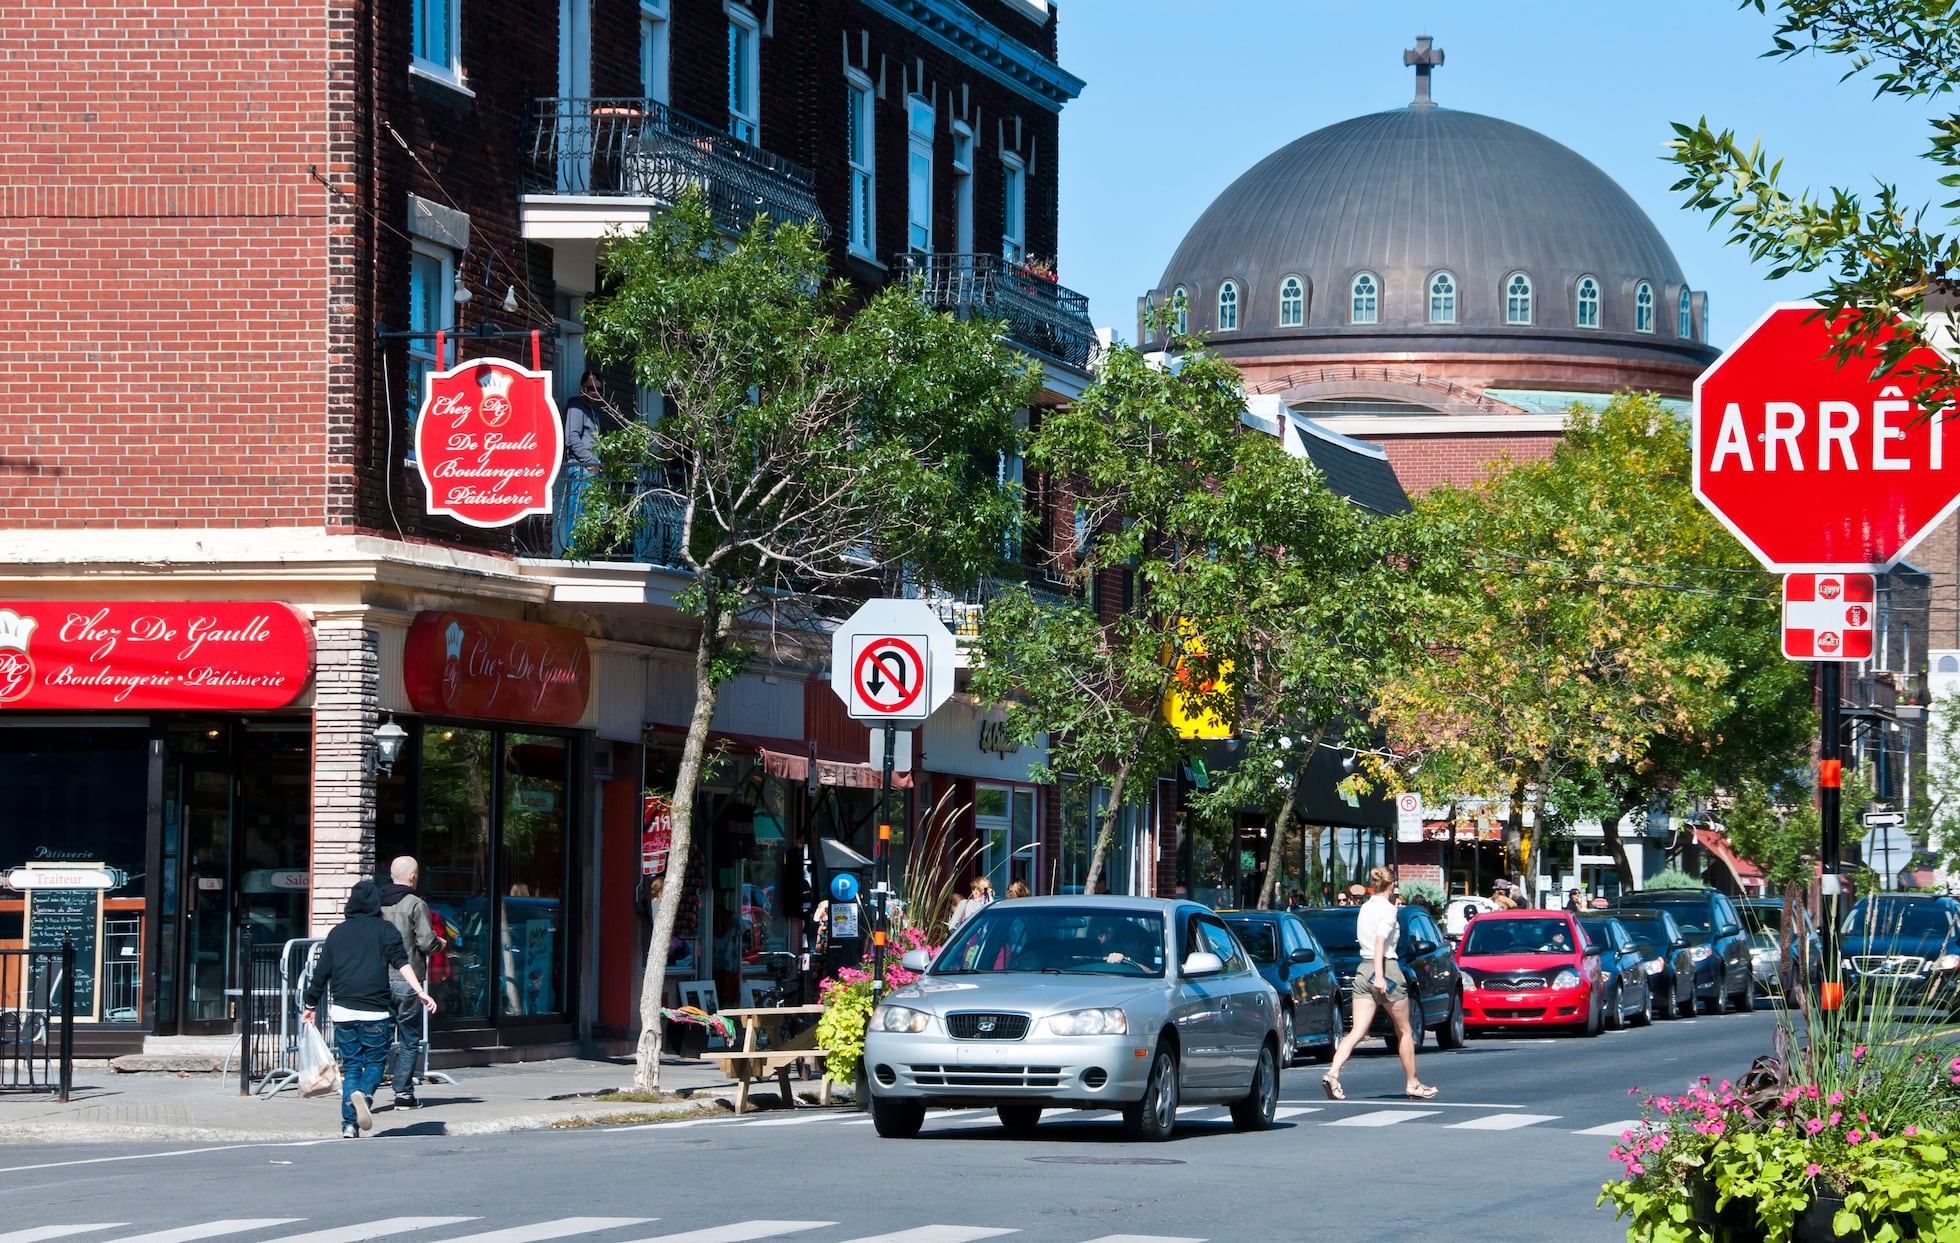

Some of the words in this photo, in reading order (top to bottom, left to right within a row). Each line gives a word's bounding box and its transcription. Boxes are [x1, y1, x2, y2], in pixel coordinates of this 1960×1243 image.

[432, 392, 472, 428] Chez
[1710, 386, 1956, 471] ARRÊT
[446, 433, 478, 451] De
[478, 432, 538, 462] Gaulle
[433, 457, 545, 492] Boulangerie
[445, 486, 533, 504] Pâtisserie
[59, 607, 122, 663] Chez
[127, 615, 177, 642] De
[177, 615, 272, 661] Gaulle
[469, 624, 504, 712] Chez
[507, 640, 535, 681] De
[35, 873, 83, 885] Traiteur
